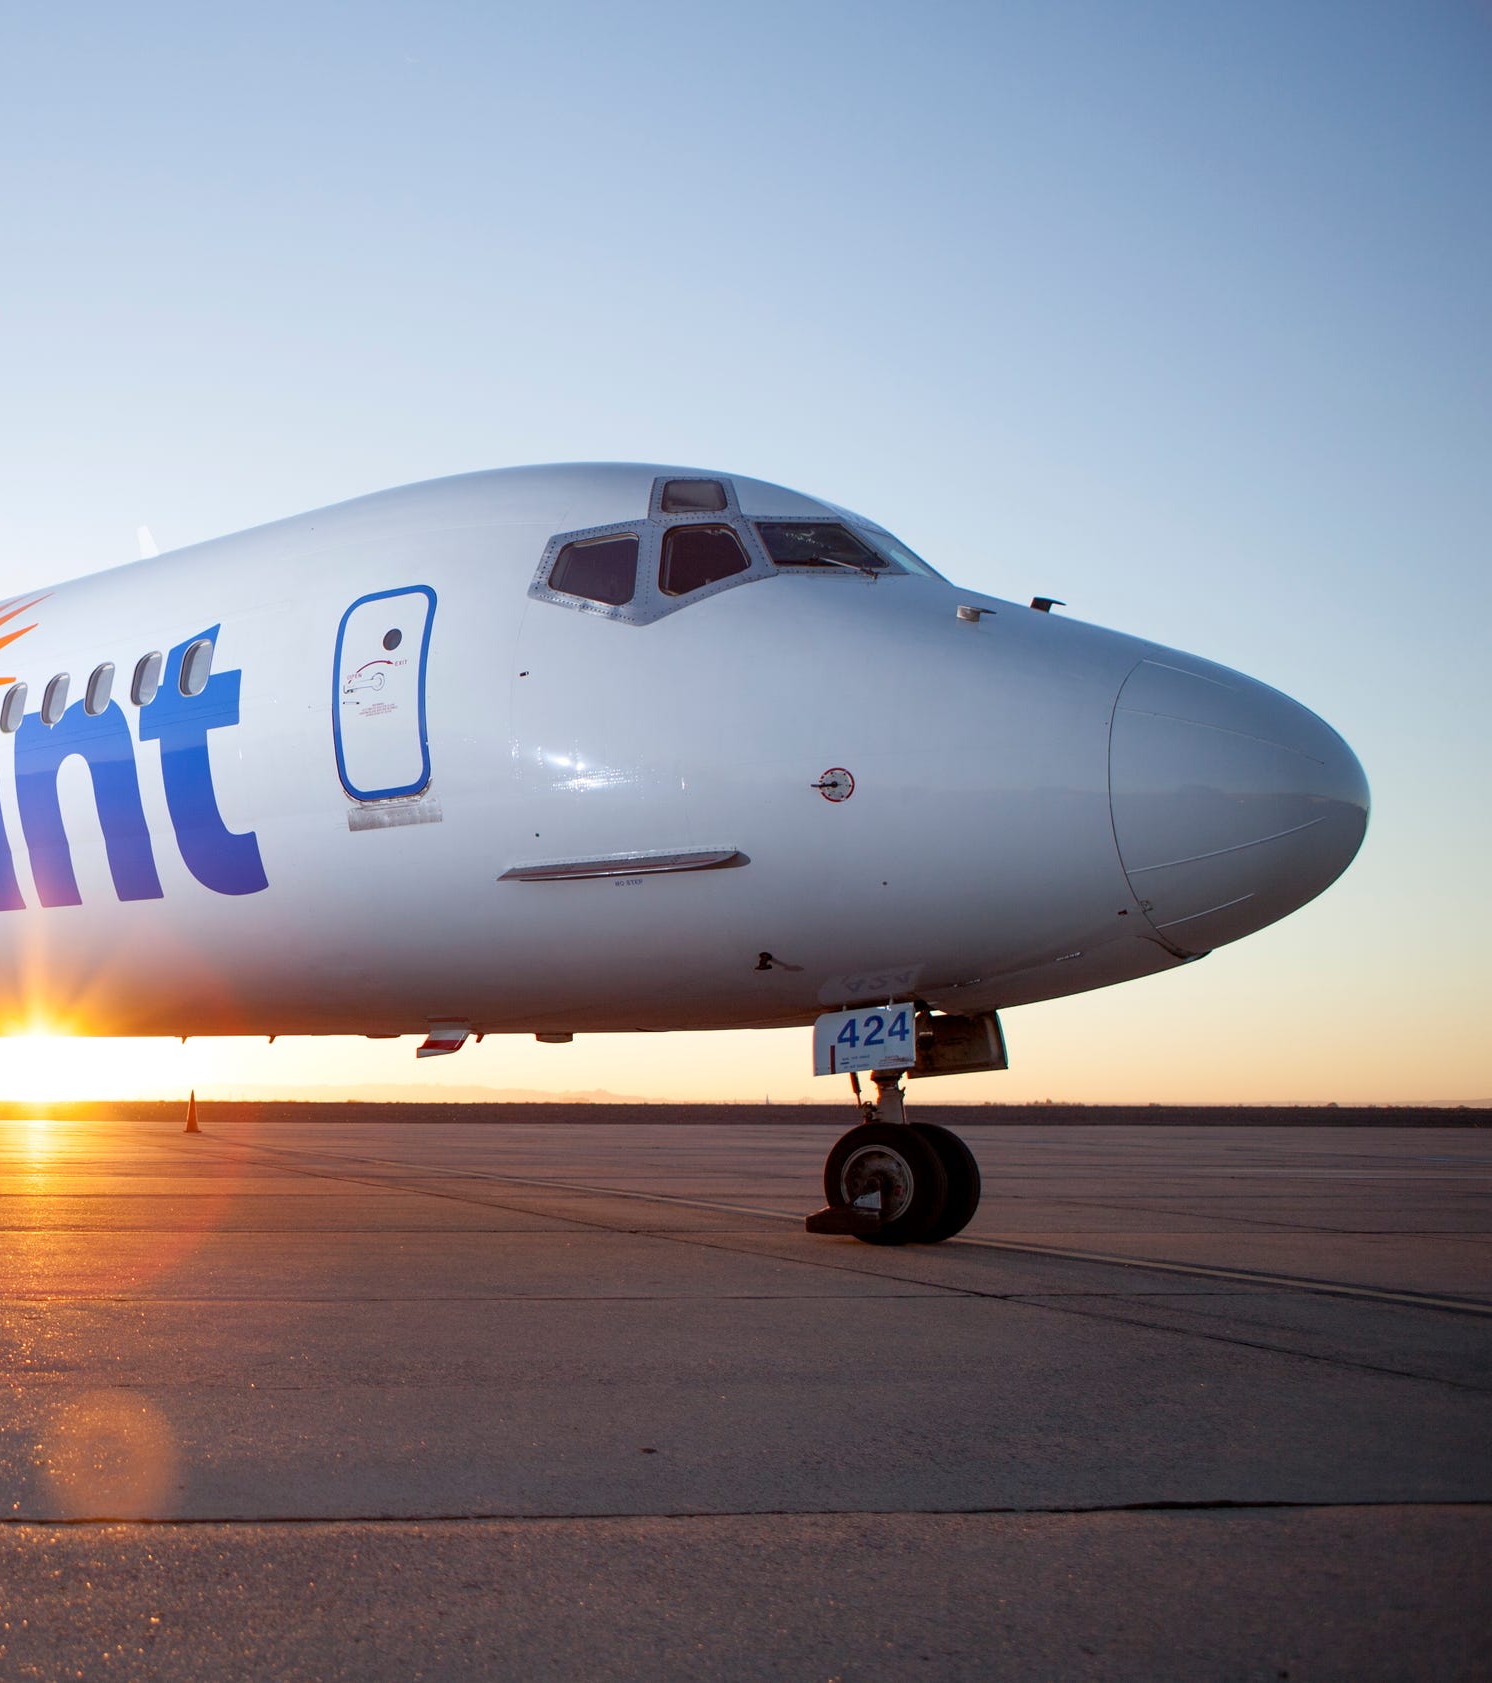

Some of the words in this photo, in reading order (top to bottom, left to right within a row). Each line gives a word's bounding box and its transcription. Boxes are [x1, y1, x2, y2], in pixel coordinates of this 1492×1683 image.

[394, 659, 408, 667] EXIT
[626, 878, 643, 886] STEP
[836, 1011, 910, 1049] 424
